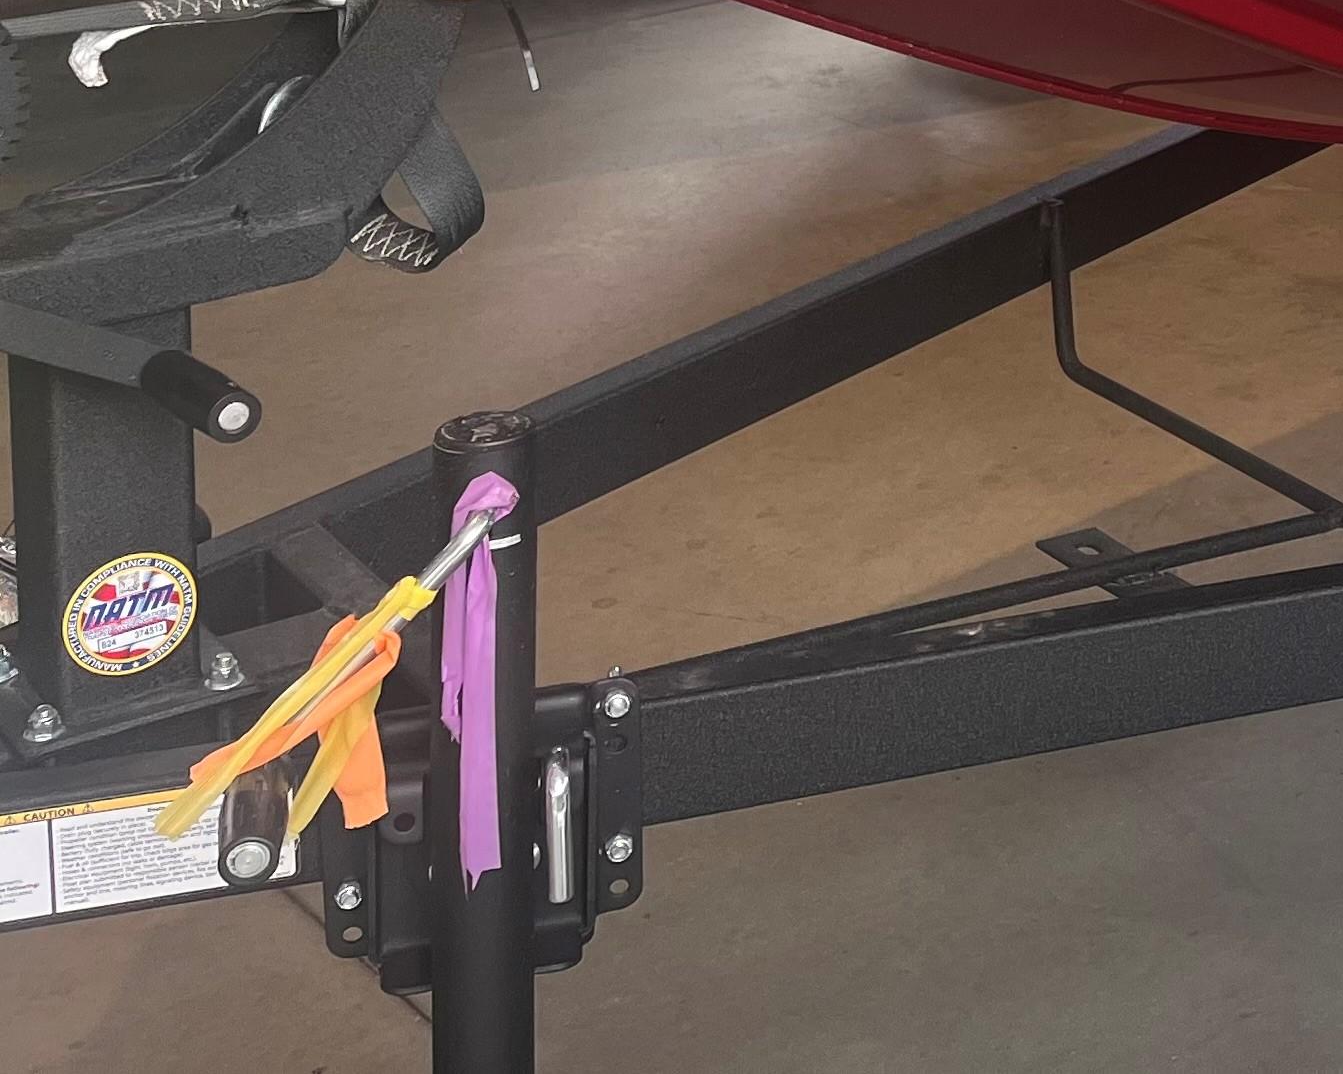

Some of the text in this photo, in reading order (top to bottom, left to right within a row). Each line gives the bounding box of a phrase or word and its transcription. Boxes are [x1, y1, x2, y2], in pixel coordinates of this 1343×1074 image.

[83, 558, 152, 597] COMPLIANCE
[153, 559, 178, 576] WITH
[23, 807, 75, 822] CAUTION
